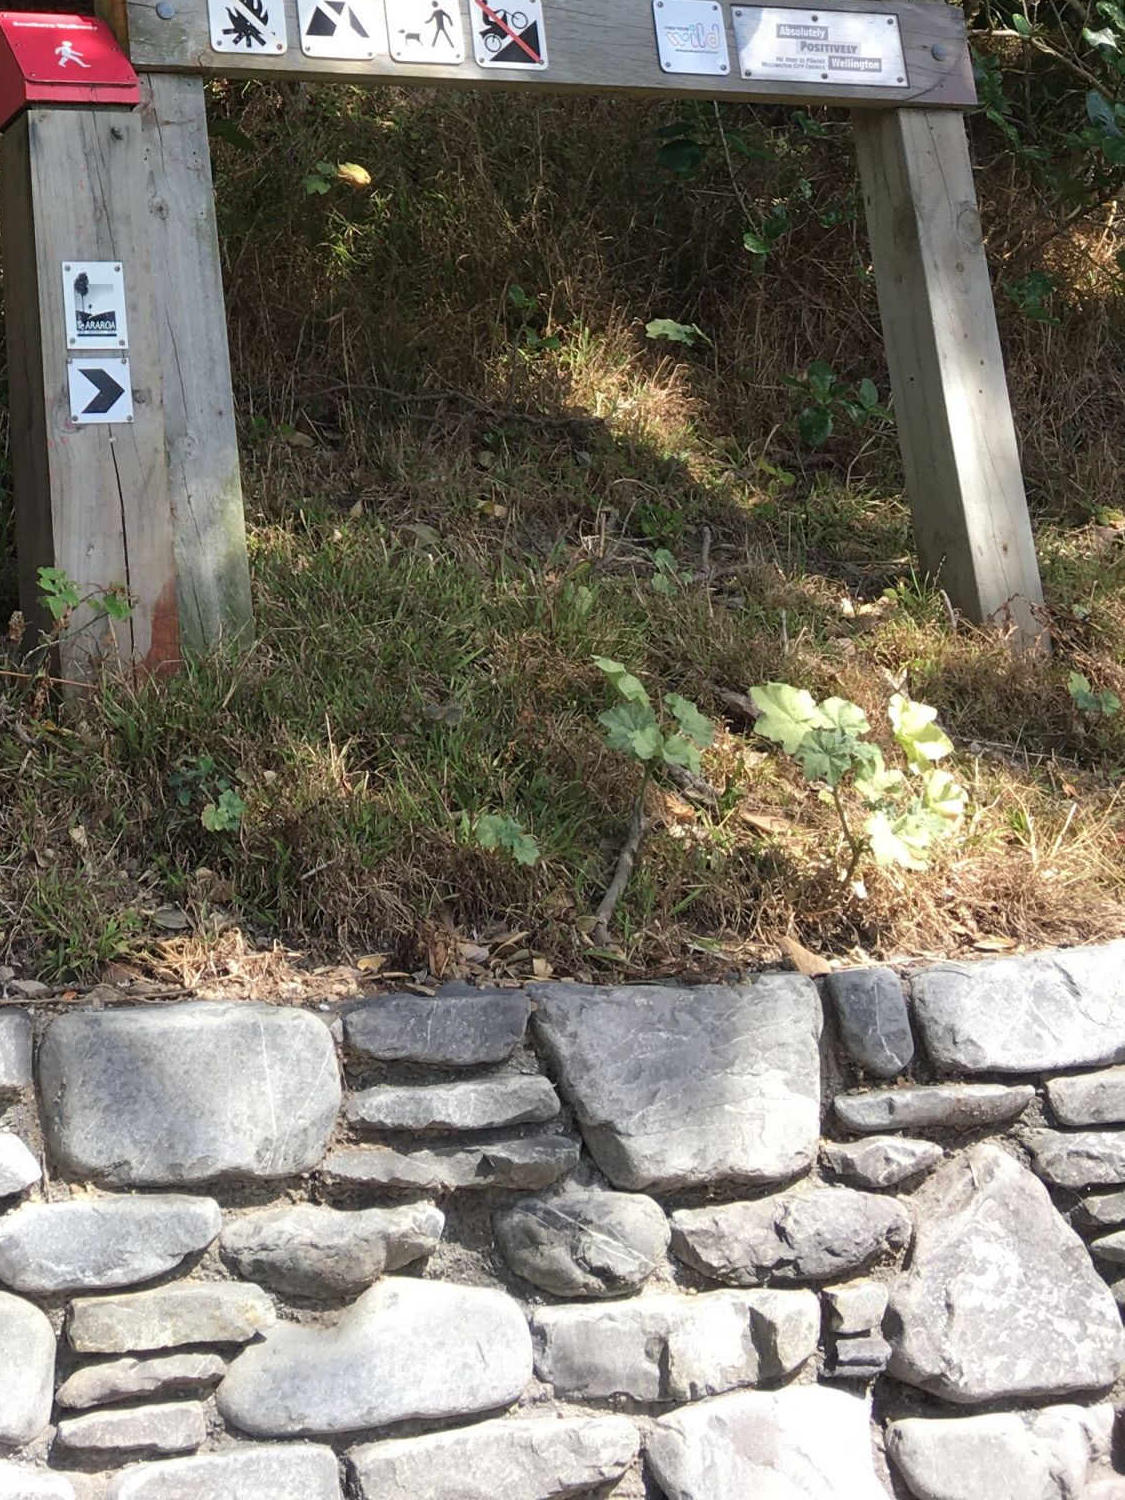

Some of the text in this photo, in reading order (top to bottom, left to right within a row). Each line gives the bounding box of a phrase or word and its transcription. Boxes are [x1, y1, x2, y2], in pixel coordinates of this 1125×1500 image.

[779, 26, 826, 39] Absolutely
[831, 57, 880, 71] Wellington
[85, 320, 116, 330] ARAROA
